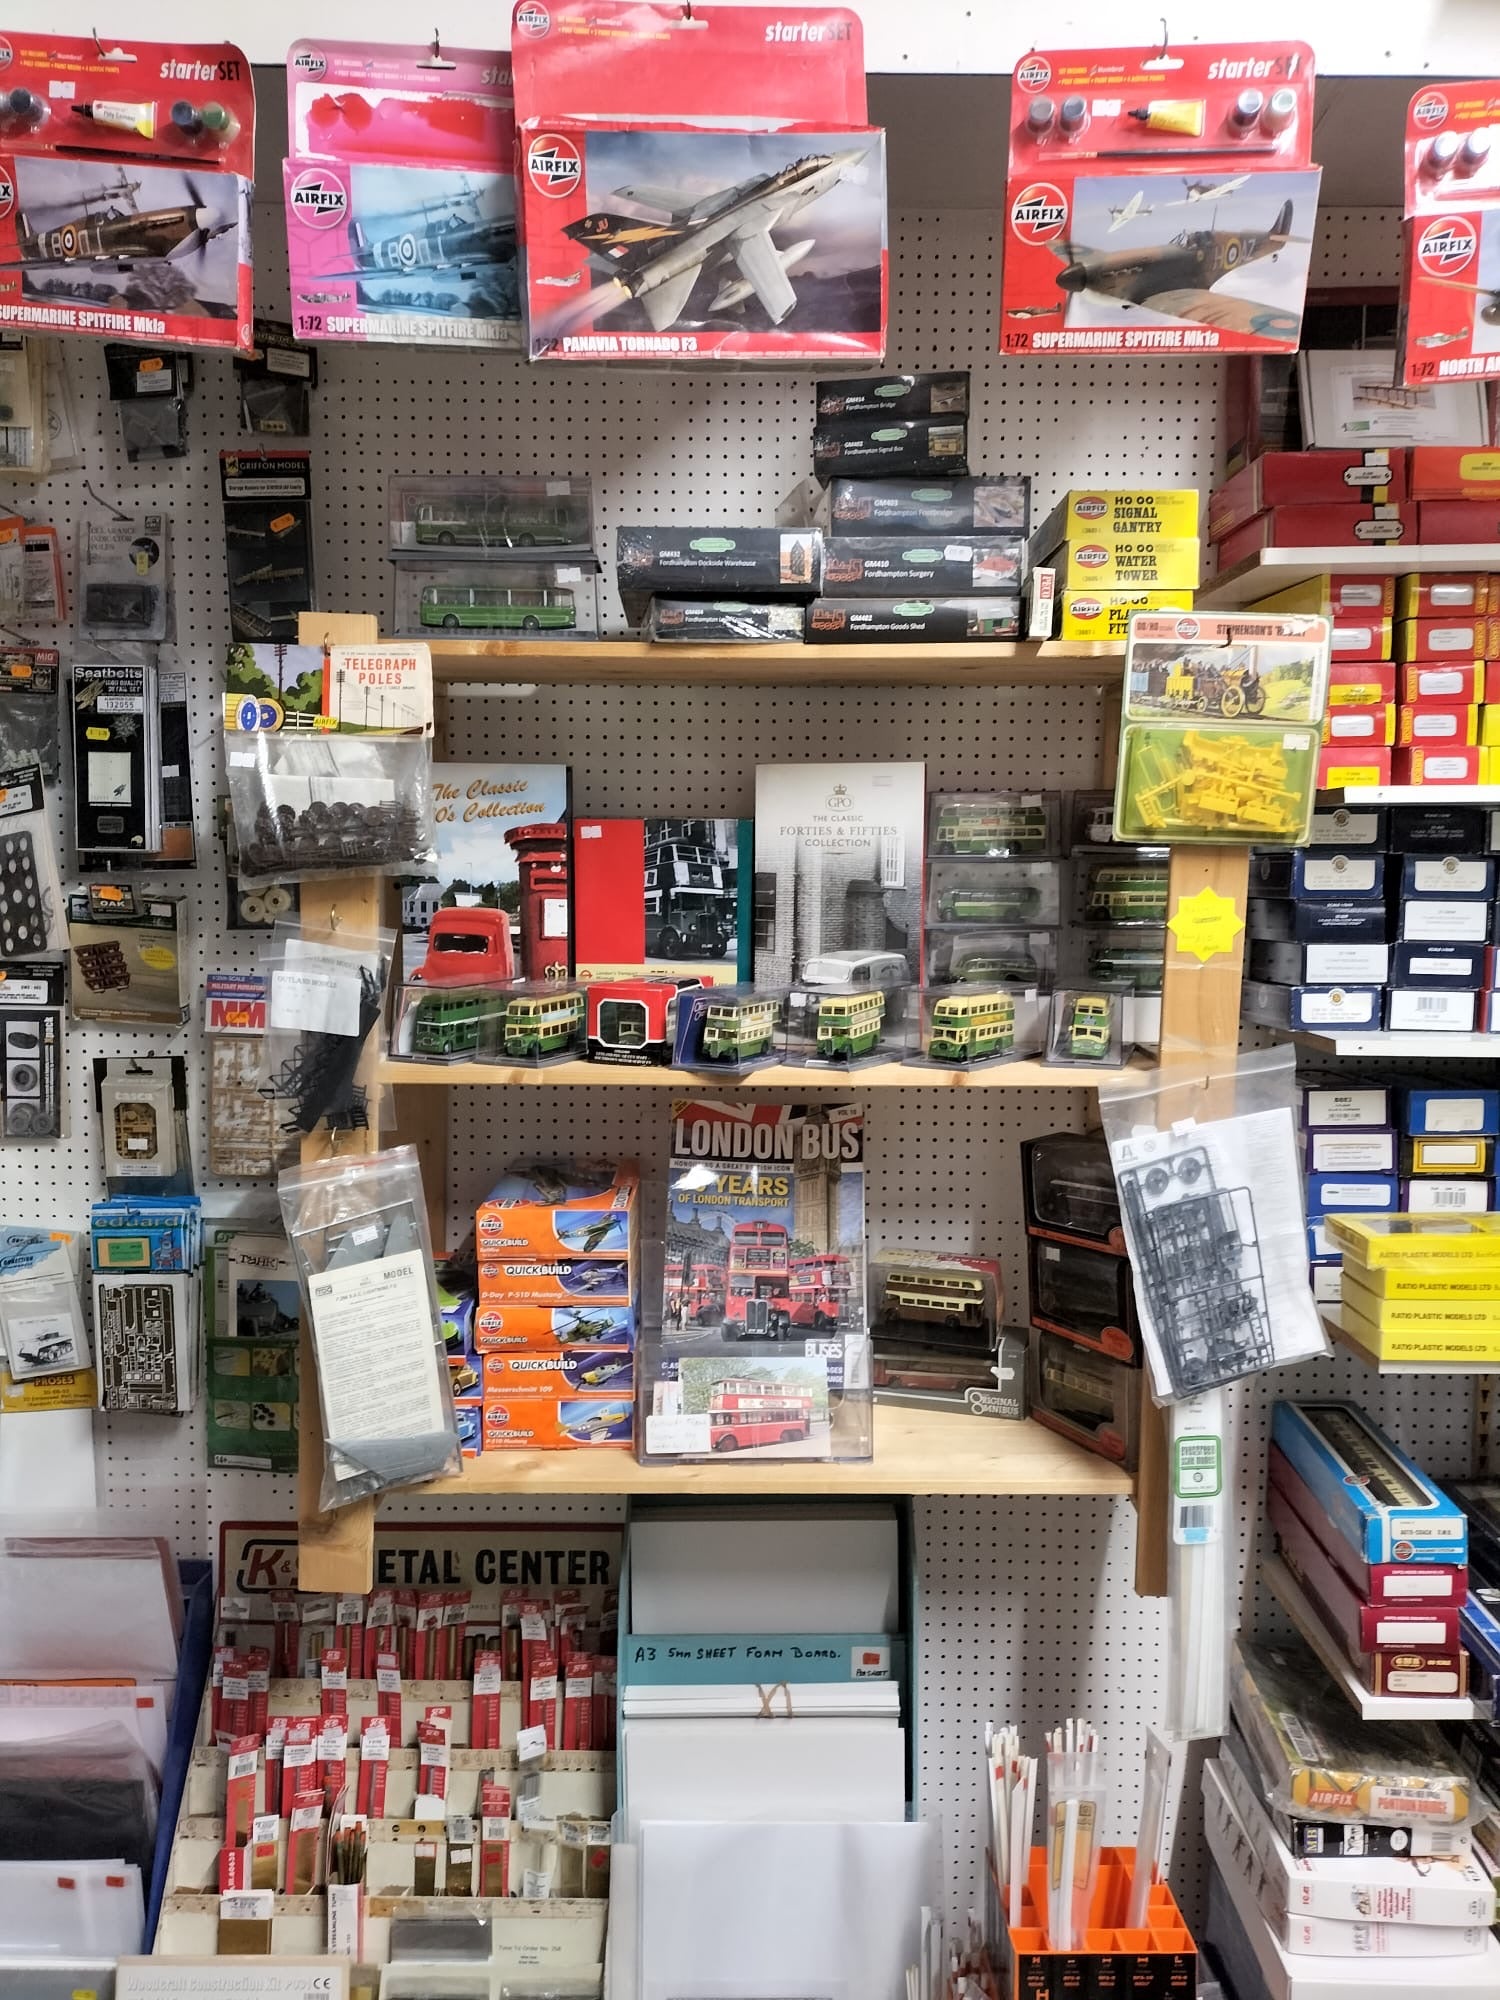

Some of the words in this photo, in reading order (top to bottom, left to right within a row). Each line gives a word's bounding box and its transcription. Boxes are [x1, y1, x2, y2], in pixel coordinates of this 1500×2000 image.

[518, 15, 548, 24] AIRFIX
[295, 59, 324, 67] AIRFIX
[1020, 71, 1049, 80] AIRFIX
[531, 156, 580, 175] AIRFIX
[294, 191, 345, 207] AIRFIX
[1013, 206, 1066, 222] AIRFIX
[1422, 237, 1474, 254] AIRFIX
[0, 304, 77, 326] UPERMARINE
[78, 312, 132, 331] SPITFIRE
[298, 316, 322, 331] 1:72
[327, 316, 417, 336] SUPERMARINE
[418, 322, 474, 339] SPITFIRE
[562, 336, 617, 353] PANAVIA
[620, 336, 680, 352] TORNADO
[681, 336, 697, 351] F3
[1005, 333, 1029, 349] 1:72
[1032, 331, 1124, 350] SUPERMARINE
[1125, 331, 1183, 348] SPITFIRE
[1411, 361, 1435, 378] 1:72
[1439, 356, 1483, 375] NORTH
[239, 462, 276, 470] GRIFFON
[1115, 496, 1132, 505] HO
[1137, 496, 1154, 505] OO
[874, 510, 917, 519] Fordhampton
[1113, 507, 1158, 518] SIGNAL
[1113, 522, 1162, 533] GANTRY
[1115, 544, 1132, 553] HO
[1137, 544, 1154, 553] OO
[659, 559, 698, 568] Fordhampton
[698, 559, 724, 567] Dockside
[724, 559, 757, 567] Warehouse
[1115, 555, 1157, 567] WATER
[864, 569, 908, 579] Fordhampton
[909, 569, 935, 580] Surgery
[1115, 570, 1159, 581] TOWER
[850, 622, 890, 632] Fordhampton
[890, 622, 909, 630] Goods
[910, 622, 926, 630] Shed
[345, 657, 417, 671] TELEGRAPH
[74, 667, 143, 679] Seatbelts
[358, 673, 402, 685] POLES
[430, 782, 460, 802] The
[466, 778, 529, 801] Classic
[827, 797, 852, 808] GPO
[432, 804, 456, 823] 0's
[463, 801, 546, 823] Collection
[780, 826, 833, 836] FORTIES
[836, 826, 845, 836] &
[849, 825, 898, 836] FIFTIES
[804, 838, 872, 848] COLLECTION
[211, 1000, 266, 1028] MM
[114, 1091, 154, 1101] tasca
[674, 1118, 795, 1160] LONDON
[801, 1121, 860, 1160] BUS
[716, 1174, 790, 1196] YEARS
[678, 1194, 690, 1204] OF
[692, 1195, 732, 1206] LONDON
[734, 1197, 790, 1208] TRANSPORT
[94, 1216, 180, 1229] eduard
[383, 1266, 414, 1280] MODEL
[505, 1264, 572, 1276] QUICKBUILD
[1449, 1283, 1478, 1291] MODELS
[1479, 1283, 1492, 1291] LTD
[482, 1291, 504, 1299] D-Day
[1413, 1312, 1443, 1320] PLASTIC
[1391, 1343, 1412, 1351] RATIO
[1444, 1344, 1473, 1352] MODELS
[511, 1359, 577, 1370] QUICKBUILD
[35, 1375, 74, 1386] PROSES
[378, 1549, 461, 1585] ETAL
[475, 1548, 610, 1585] CENTER
[635, 1646, 657, 1663] A3
[696, 1646, 738, 1660] SHEET
[746, 1647, 784, 1659] FOAM
[1309, 1790, 1355, 1806] AIRFIX
[190, 1976, 263, 1992] Construction
